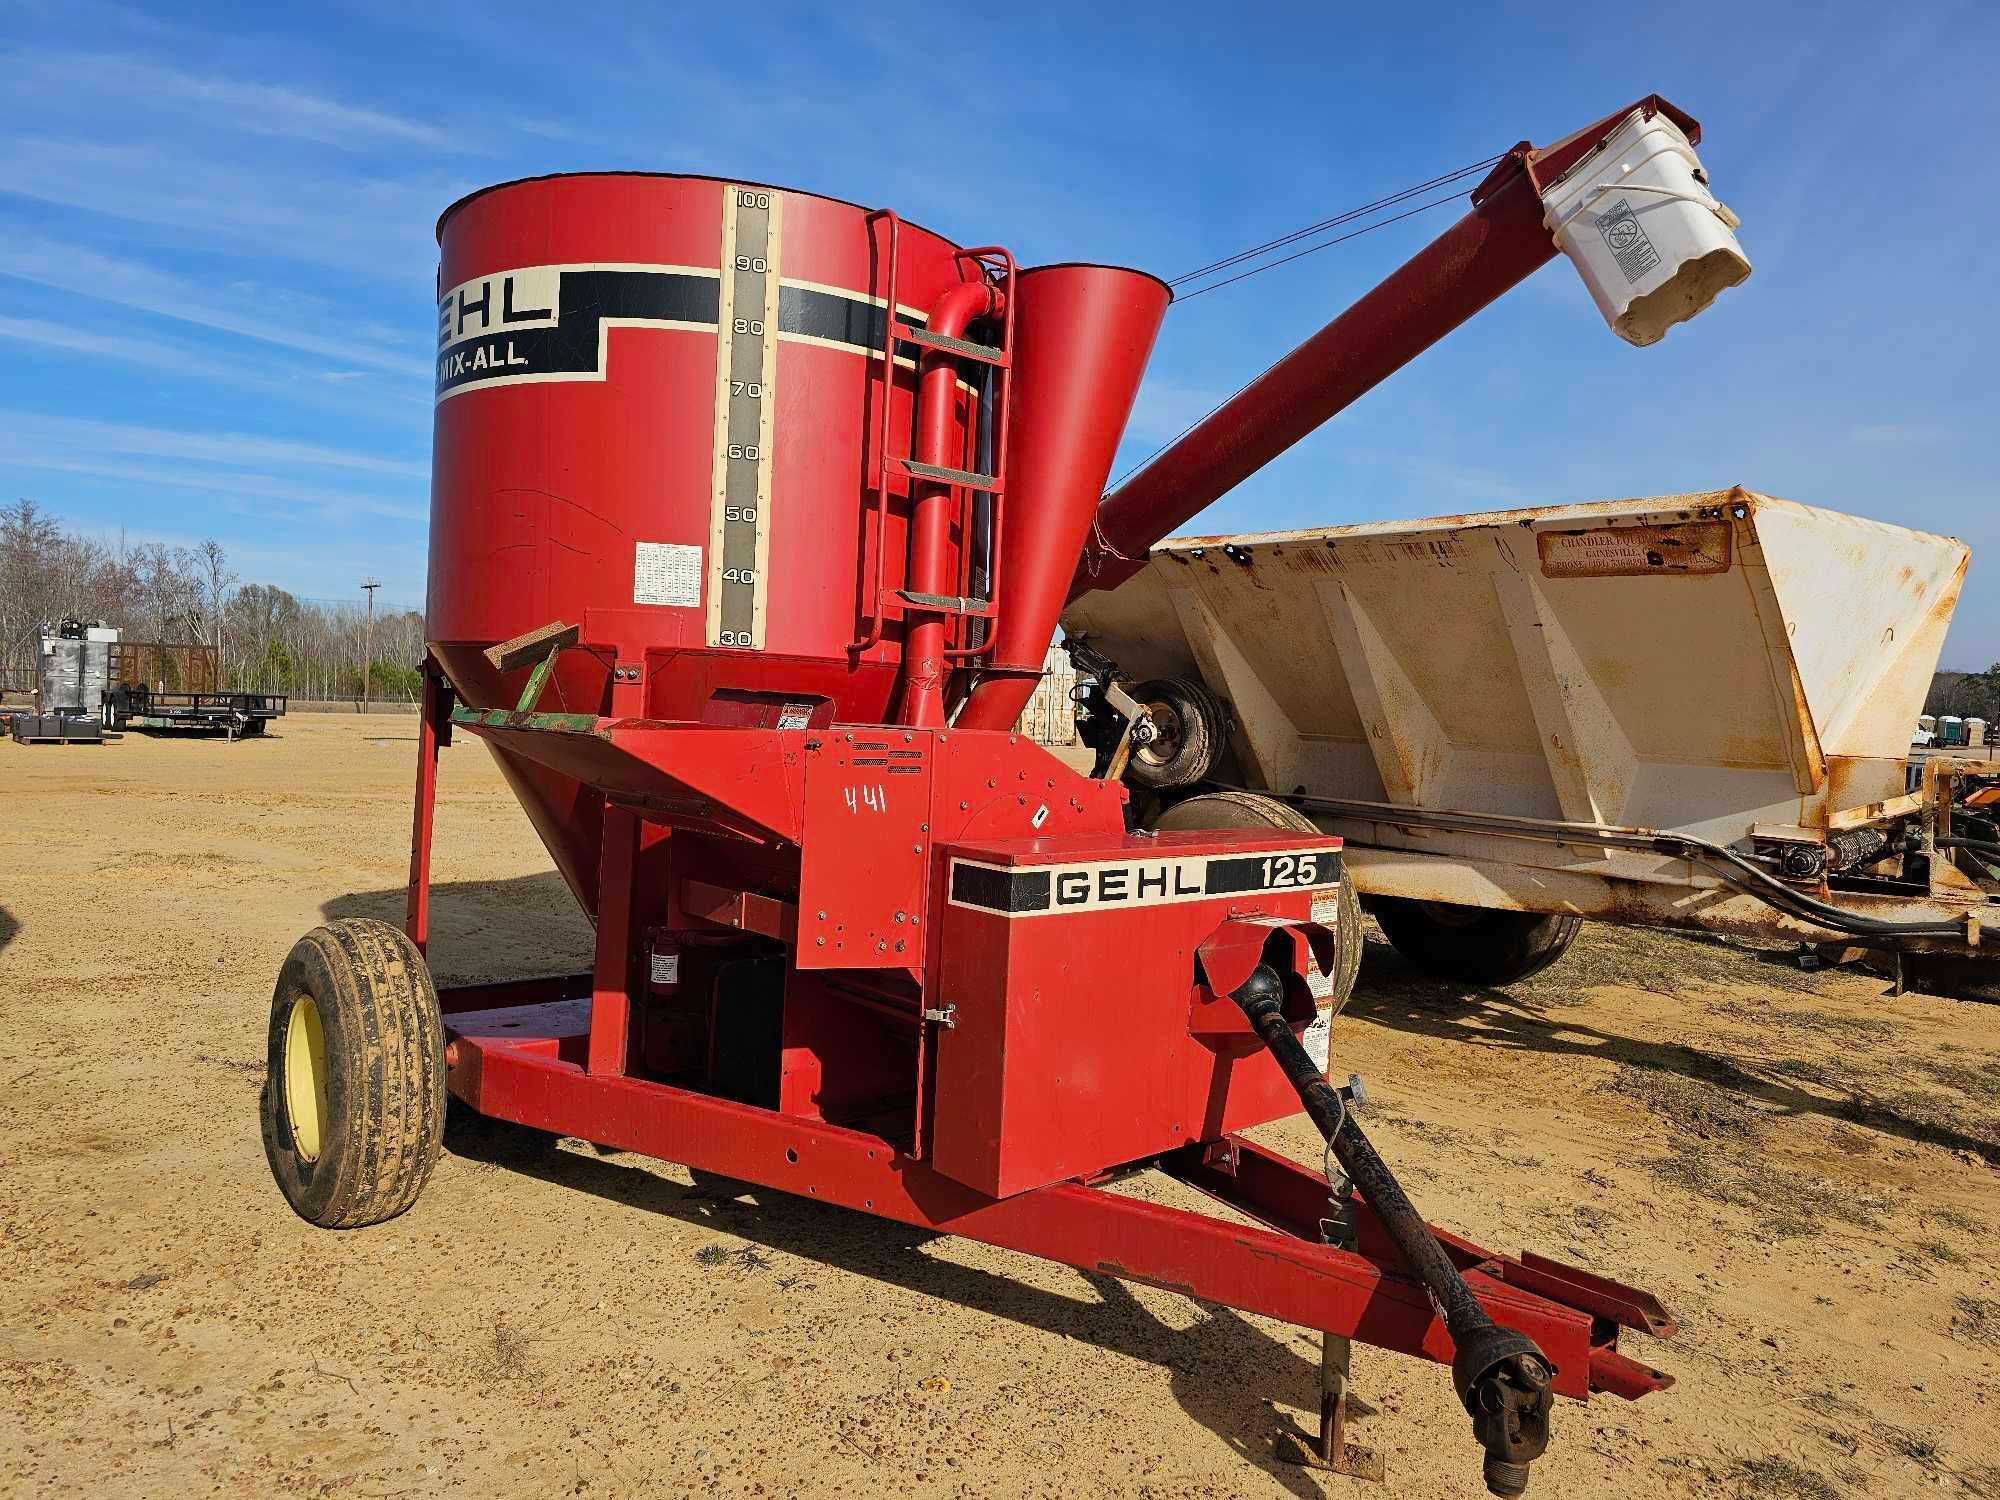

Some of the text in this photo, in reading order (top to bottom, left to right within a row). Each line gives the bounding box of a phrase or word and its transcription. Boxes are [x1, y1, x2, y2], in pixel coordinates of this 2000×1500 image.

[736, 191, 770, 209] 100
[735, 255, 768, 273] 90
[732, 318, 765, 336] 80
[731, 381, 763, 398] 70
[727, 444, 760, 461] 60
[725, 506, 757, 523] 50
[1560, 535, 1614, 549] CHANDLER
[722, 568, 755, 585] 40
[719, 630, 752, 647] 30
[1055, 855, 1318, 906] GEHL 125
